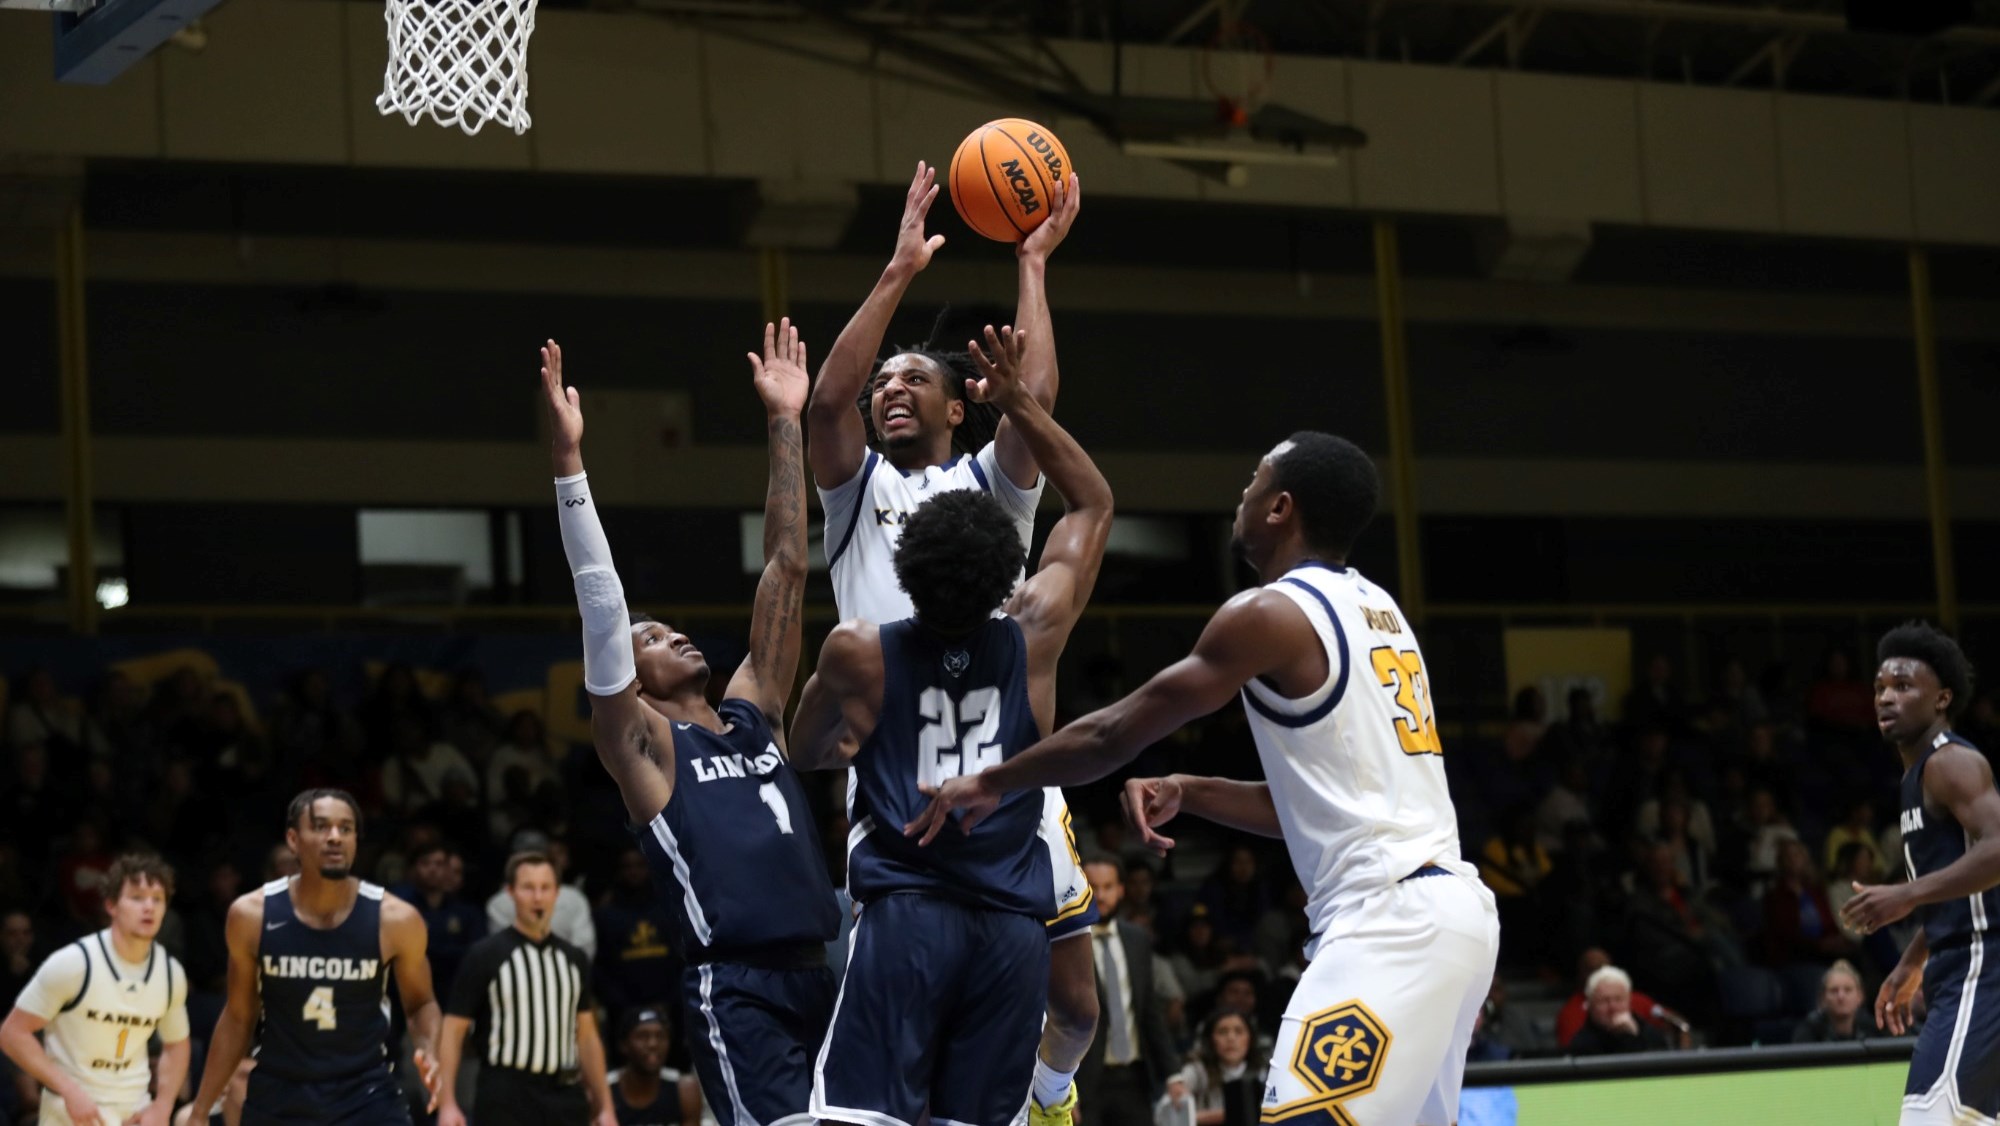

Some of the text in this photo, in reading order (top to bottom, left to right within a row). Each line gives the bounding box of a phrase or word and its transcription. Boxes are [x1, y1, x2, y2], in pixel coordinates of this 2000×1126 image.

[1001, 159, 1041, 215] NCAA
[1027, 131, 1065, 190] Wils
[917, 685, 1003, 787] 22
[759, 781, 794, 834] 1
[263, 955, 379, 980] LINCOLN
[303, 986, 337, 1030] 4
[115, 1028, 129, 1059] 1
